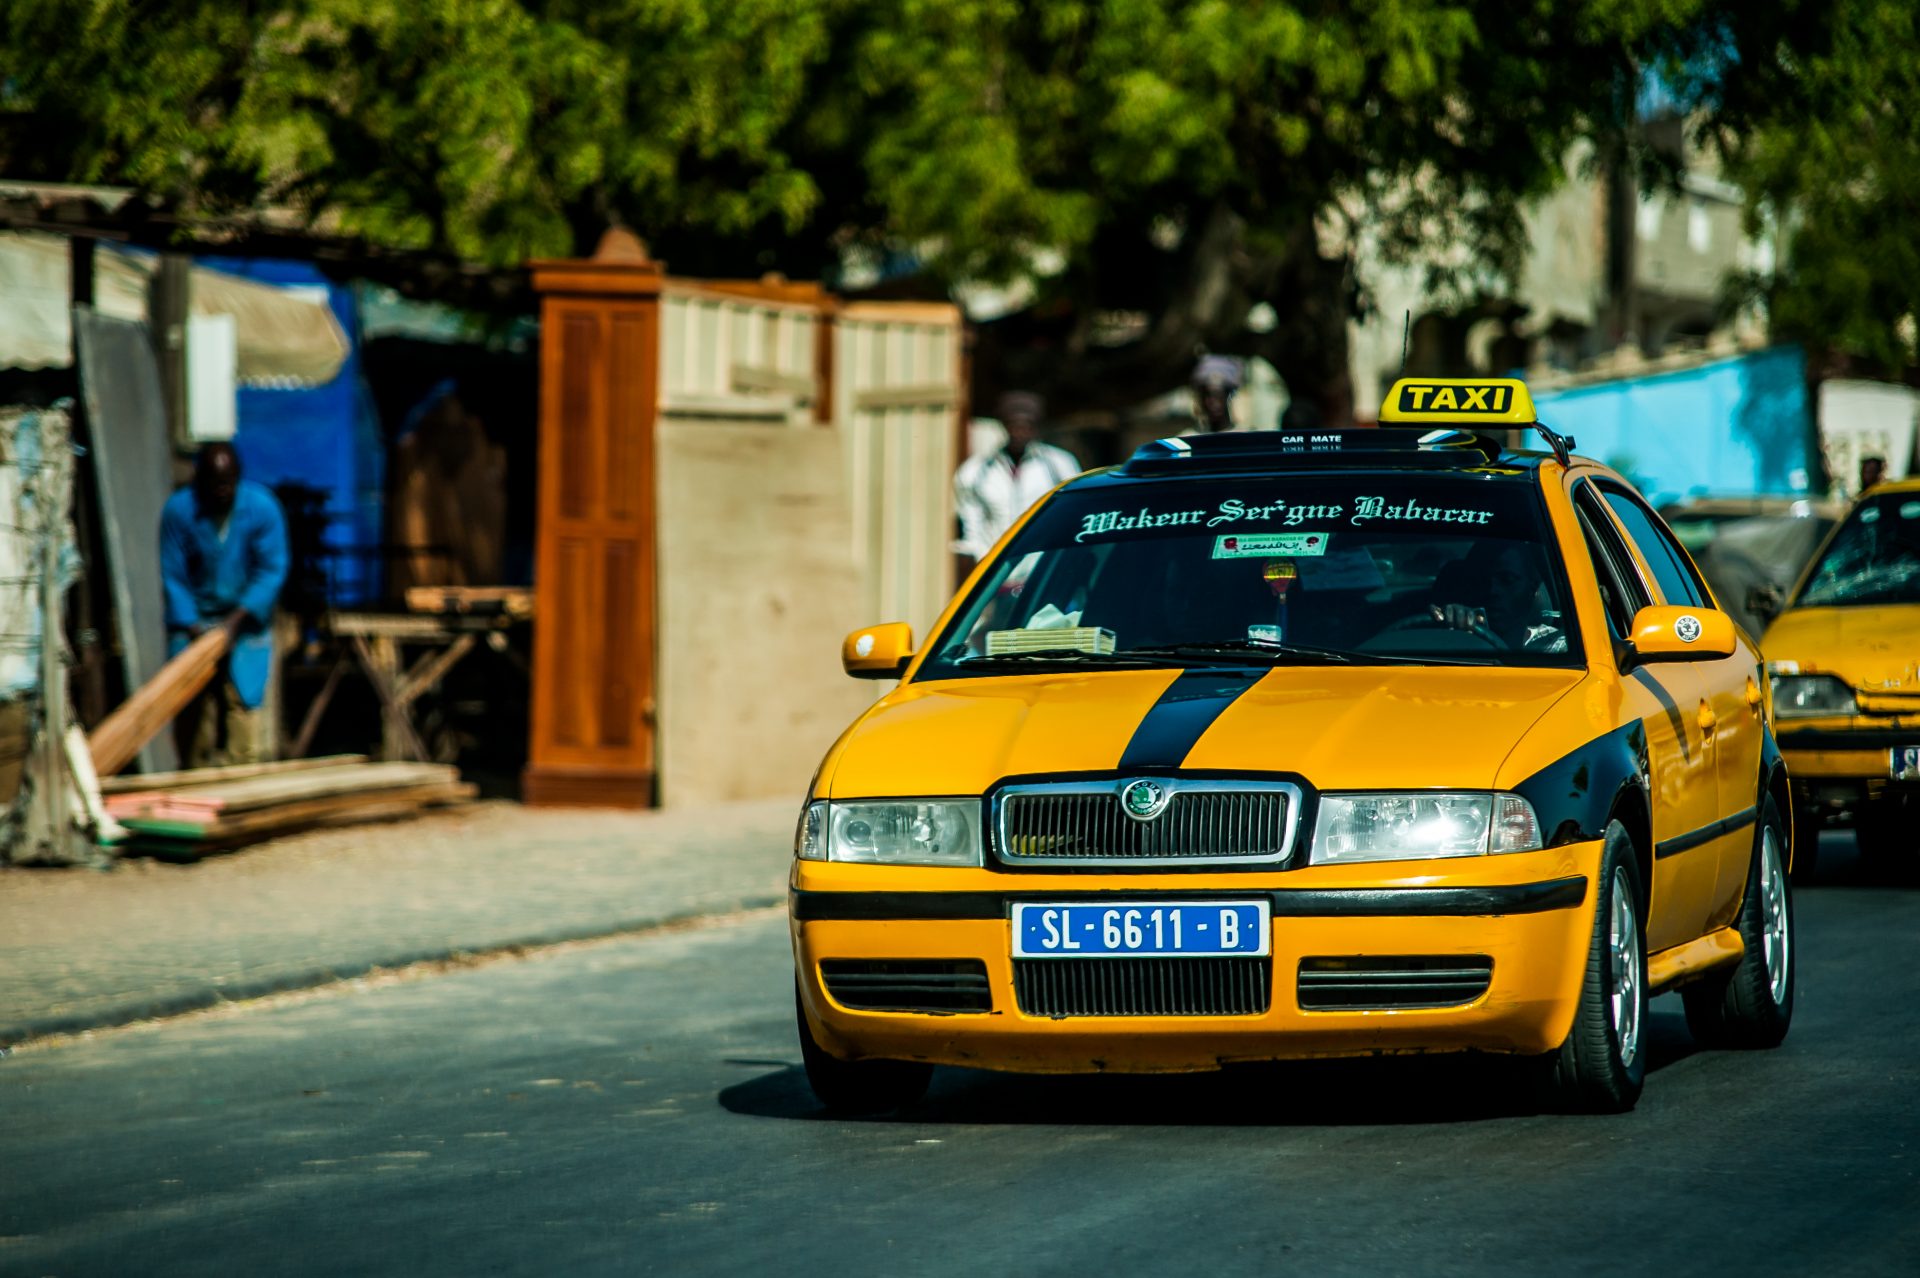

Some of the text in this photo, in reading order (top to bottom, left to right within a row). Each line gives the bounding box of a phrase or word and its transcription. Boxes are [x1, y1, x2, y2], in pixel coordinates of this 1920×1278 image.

[1407, 387, 1506, 411] TAXI
[1281, 434, 1342, 444] CAR MATE
